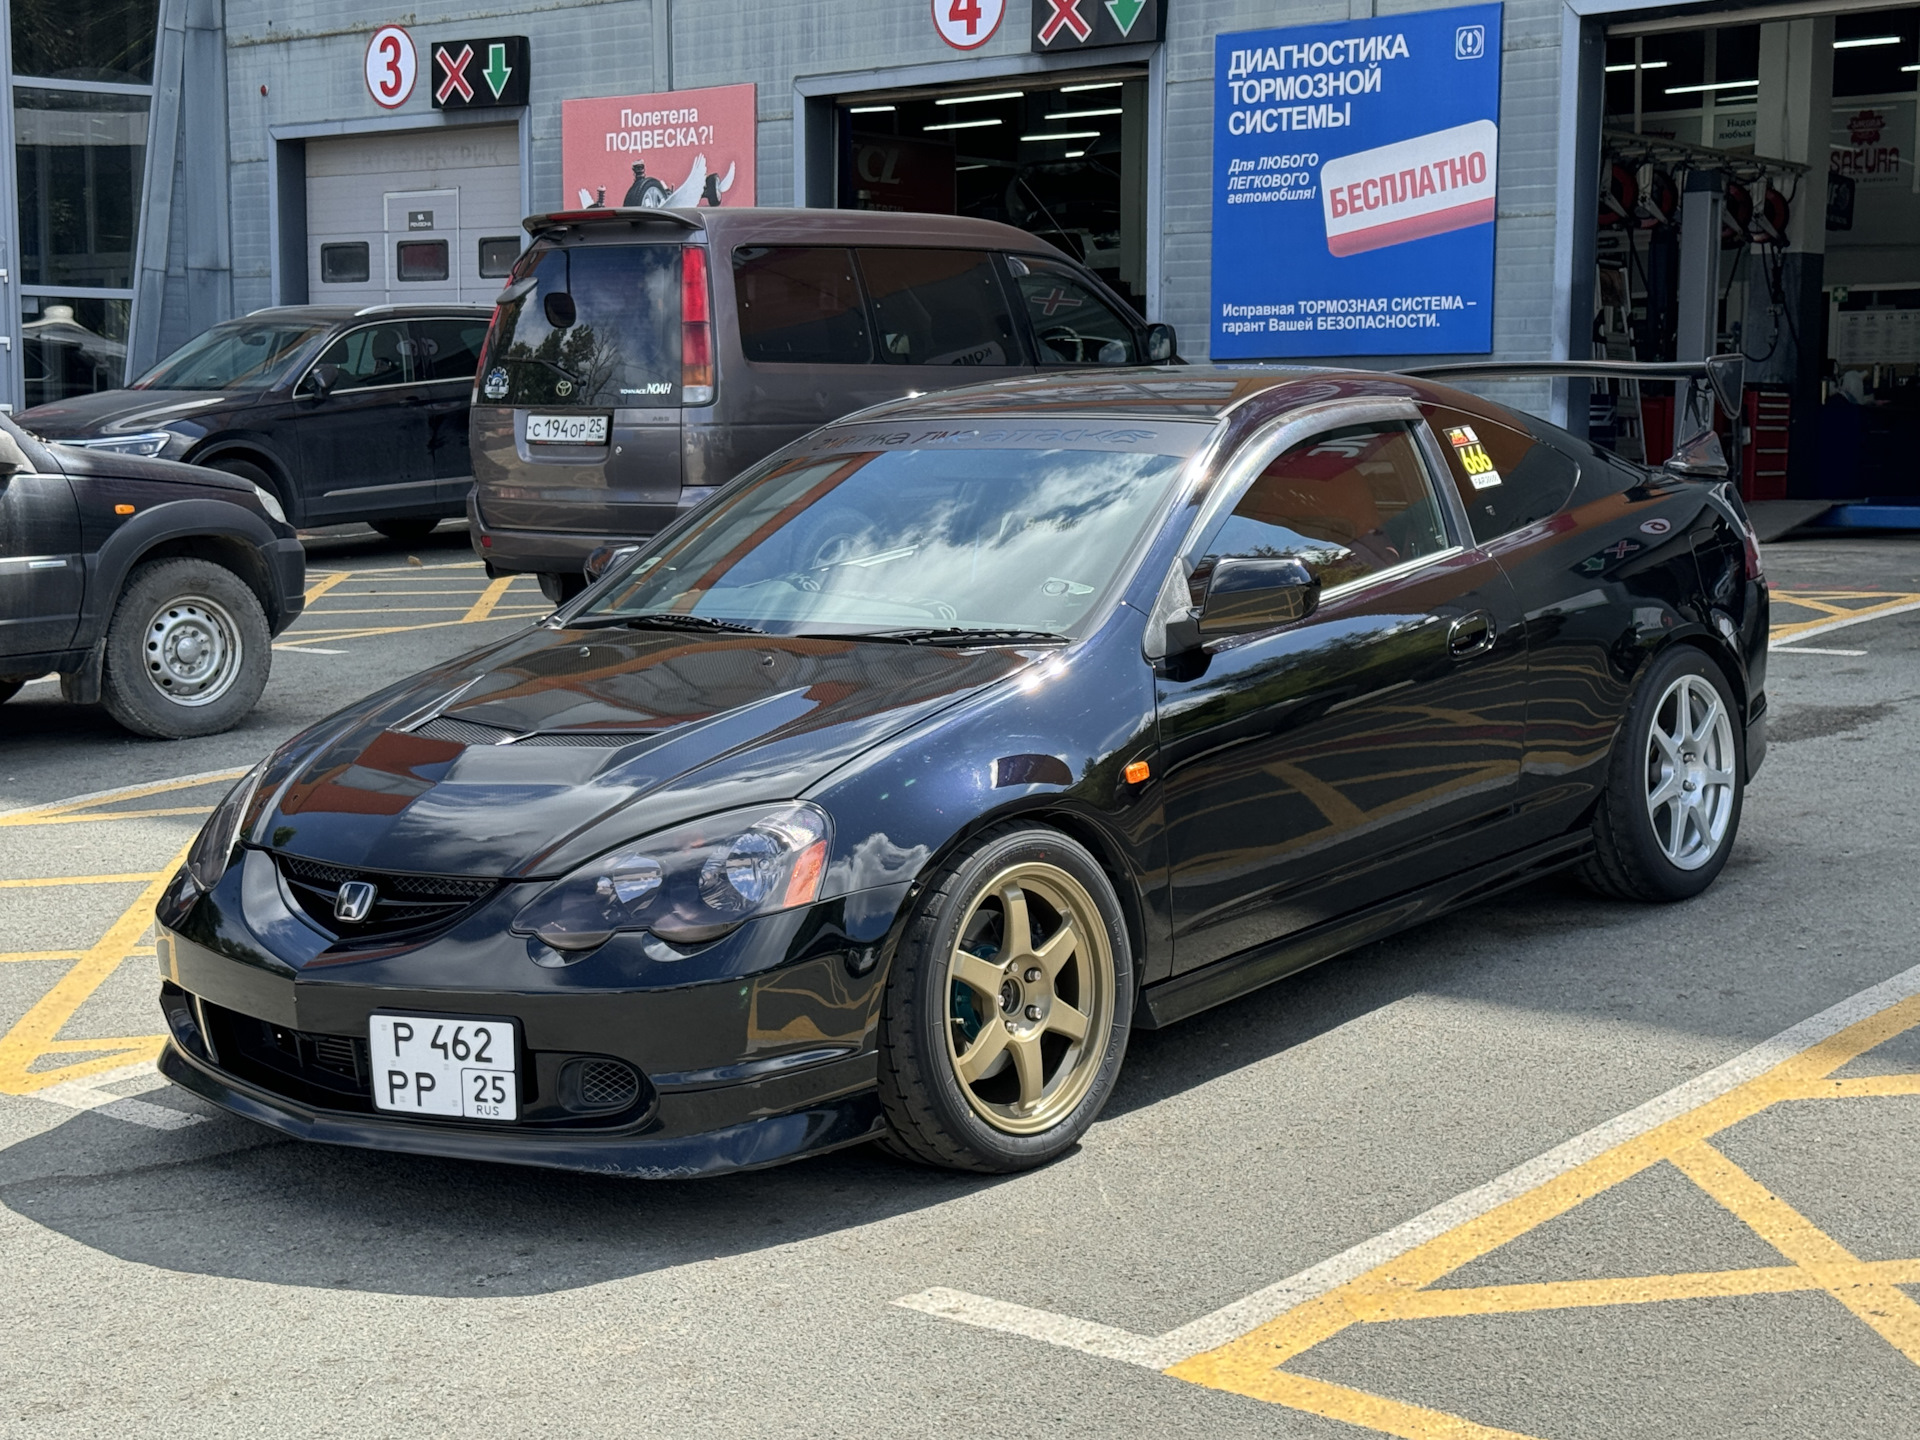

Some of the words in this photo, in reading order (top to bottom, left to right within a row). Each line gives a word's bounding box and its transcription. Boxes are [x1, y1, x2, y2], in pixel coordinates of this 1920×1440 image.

[948, 0, 982, 35] 4
[379, 35, 403, 98] 3
[1228, 33, 1410, 79] ДИАГНОСТИКА
[1228, 63, 1382, 105] ТОРМОЗНОЙ
[620, 108, 698, 128] Полетела
[1228, 102, 1351, 136] СИСТЕМЫ
[606, 125, 714, 154] ПОДВЕСКА?!
[1227, 159, 1255, 175] Для
[1257, 153, 1319, 171] ЛЮБОГО
[1830, 147, 1899, 175] SAKURA
[1227, 172, 1310, 190] ЛЕГКОВОГО
[1330, 151, 1487, 219] БЕСПЛАТНО
[1227, 186, 1317, 205] автомобиля!
[1222, 303, 1295, 319] Исправная
[1298, 298, 1388, 315] ТОРМОЗНАЯ
[1391, 295, 1464, 312] СИСТЕМА
[1222, 320, 1266, 336] гарант
[1268, 317, 1314, 333] Вашей
[1316, 313, 1440, 331] БЕЗОПАСНОСТИ.
[646, 382, 672, 395] NOAH
[589, 418, 602, 433] 25
[1460, 444, 1493, 475] 666
[393, 1022, 414, 1057] Р
[430, 1025, 493, 1063] 462
[388, 1069, 437, 1107] РР
[473, 1075, 506, 1104] 25
[476, 1104, 500, 1116] RUS
